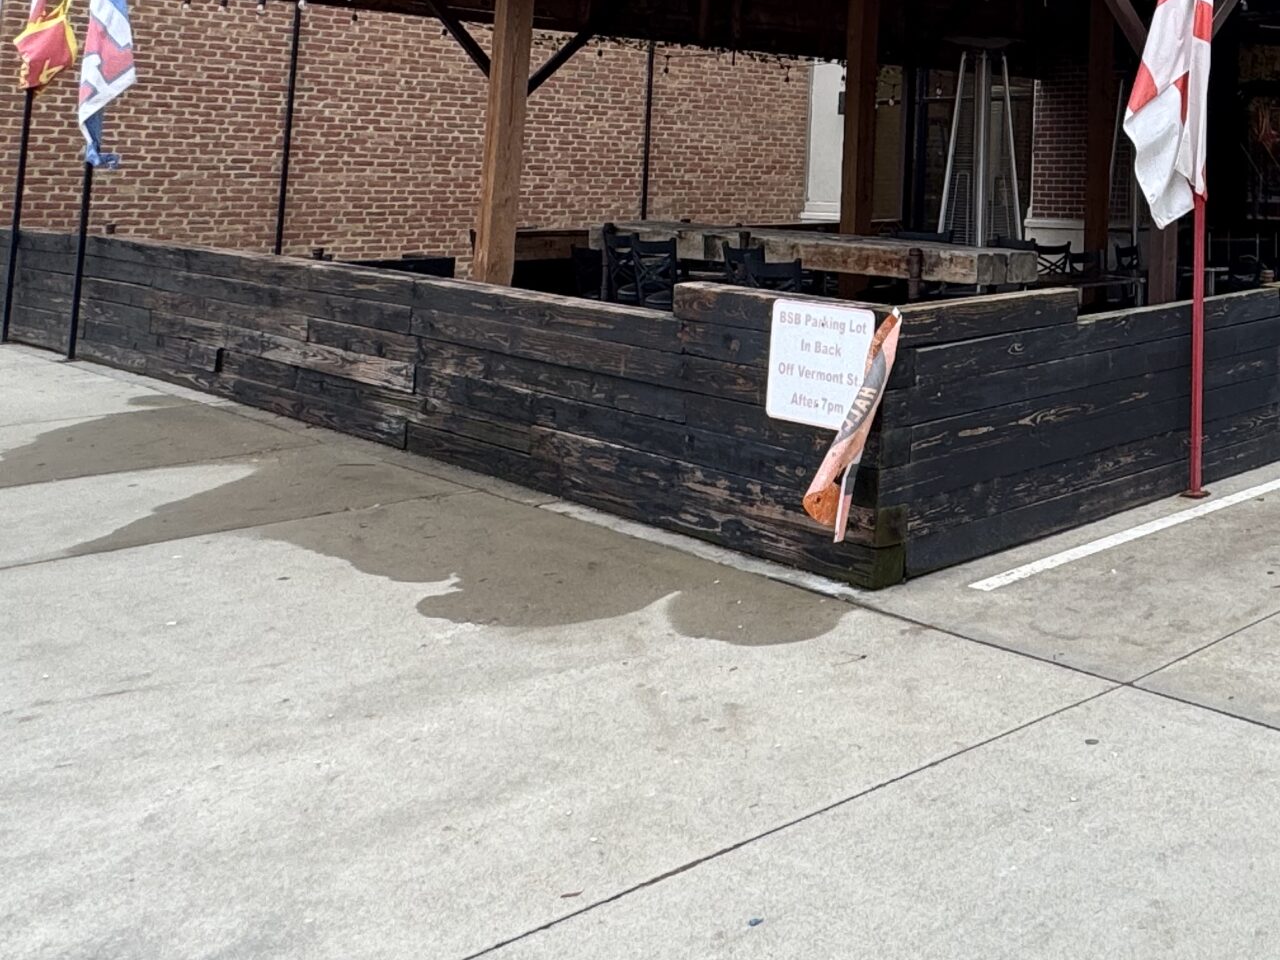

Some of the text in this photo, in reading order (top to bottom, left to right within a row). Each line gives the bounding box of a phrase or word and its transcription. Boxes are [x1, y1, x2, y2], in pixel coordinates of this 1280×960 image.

[779, 311, 867, 335] BSB Parking Lot
[800, 339, 842, 357] In Back
[778, 362, 794, 376] Off
[797, 365, 846, 385] Vermont
[790, 392, 844, 415] After 7pm
